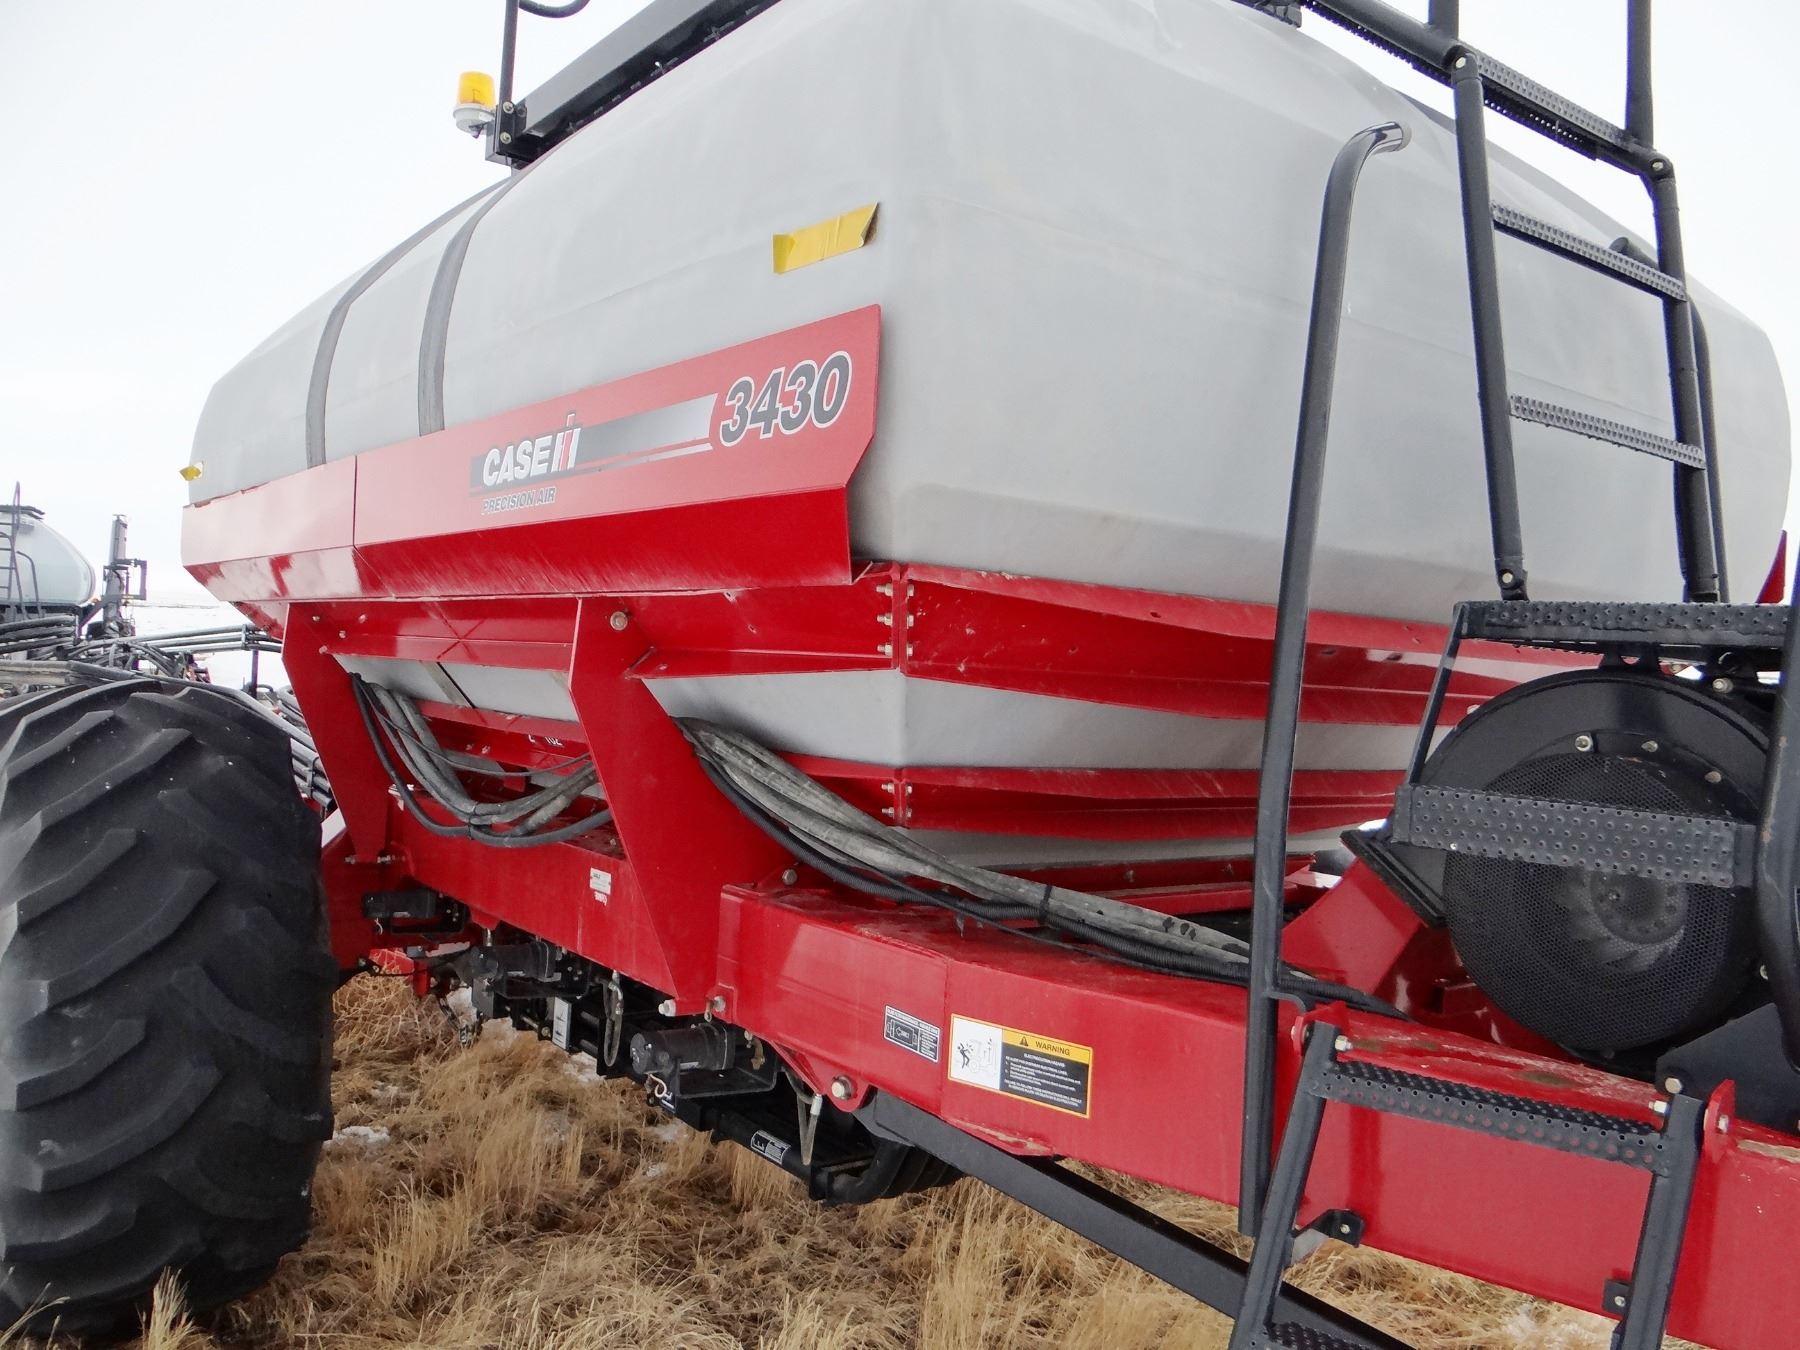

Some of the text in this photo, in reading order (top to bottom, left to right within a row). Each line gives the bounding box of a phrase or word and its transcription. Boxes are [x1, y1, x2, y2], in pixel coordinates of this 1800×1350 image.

[719, 350, 852, 447] 3430
[481, 486, 557, 515] PRECISION AIR
[1035, 1040, 1071, 1056] WARNING
